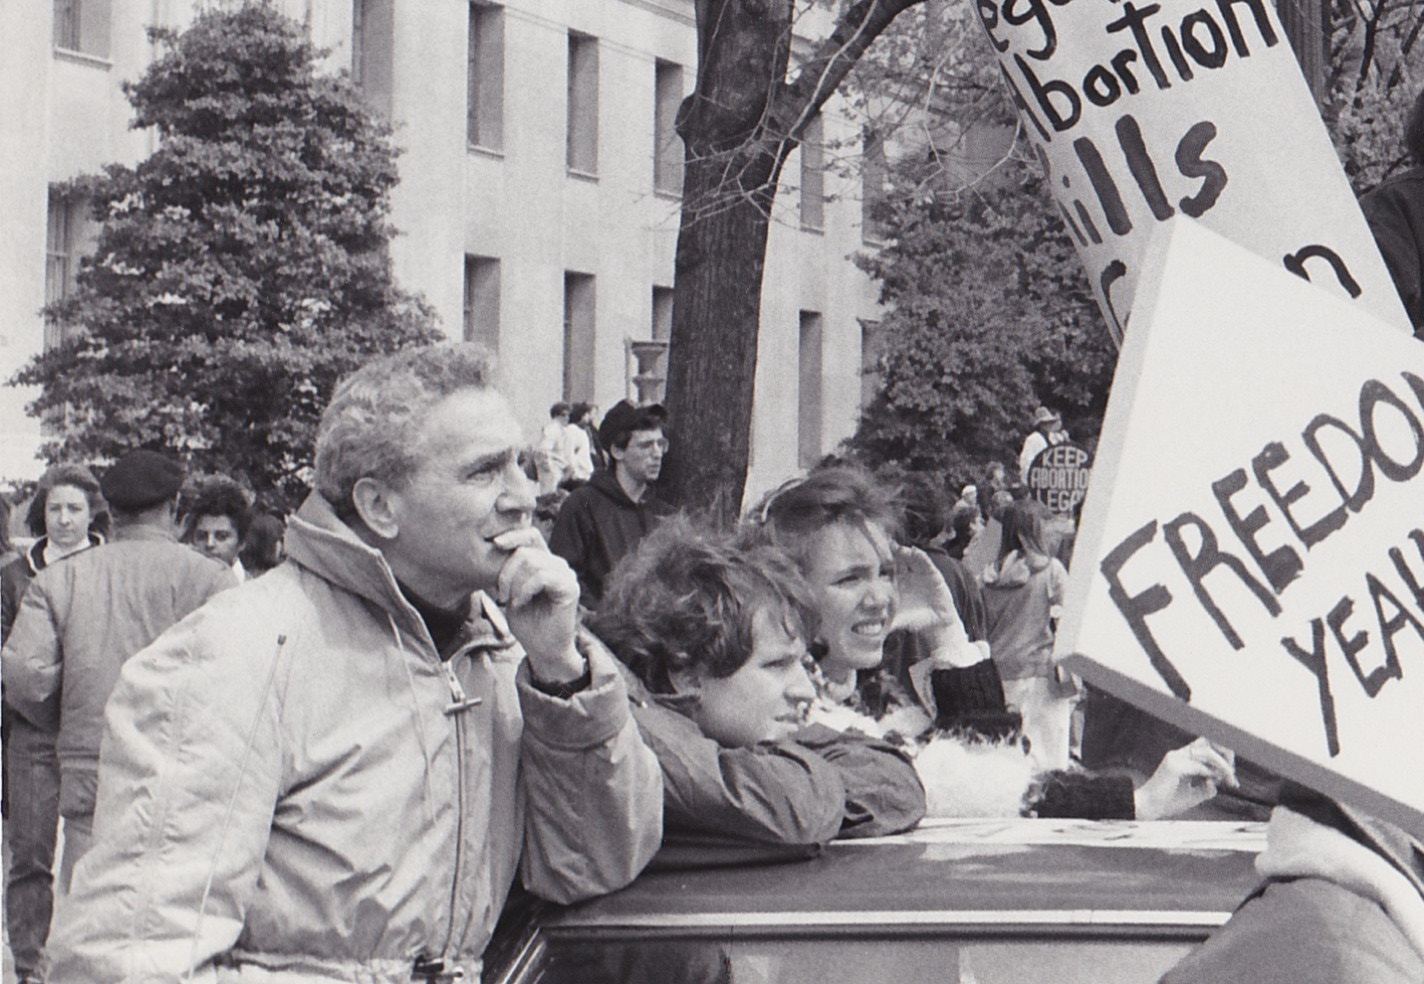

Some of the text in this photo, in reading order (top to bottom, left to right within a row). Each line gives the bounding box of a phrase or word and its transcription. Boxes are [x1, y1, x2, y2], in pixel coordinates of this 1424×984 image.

[1042, 446, 1089, 468] KEEP
[1031, 466, 1090, 490] ABORTIO
[1036, 489, 1085, 512] LEGA
